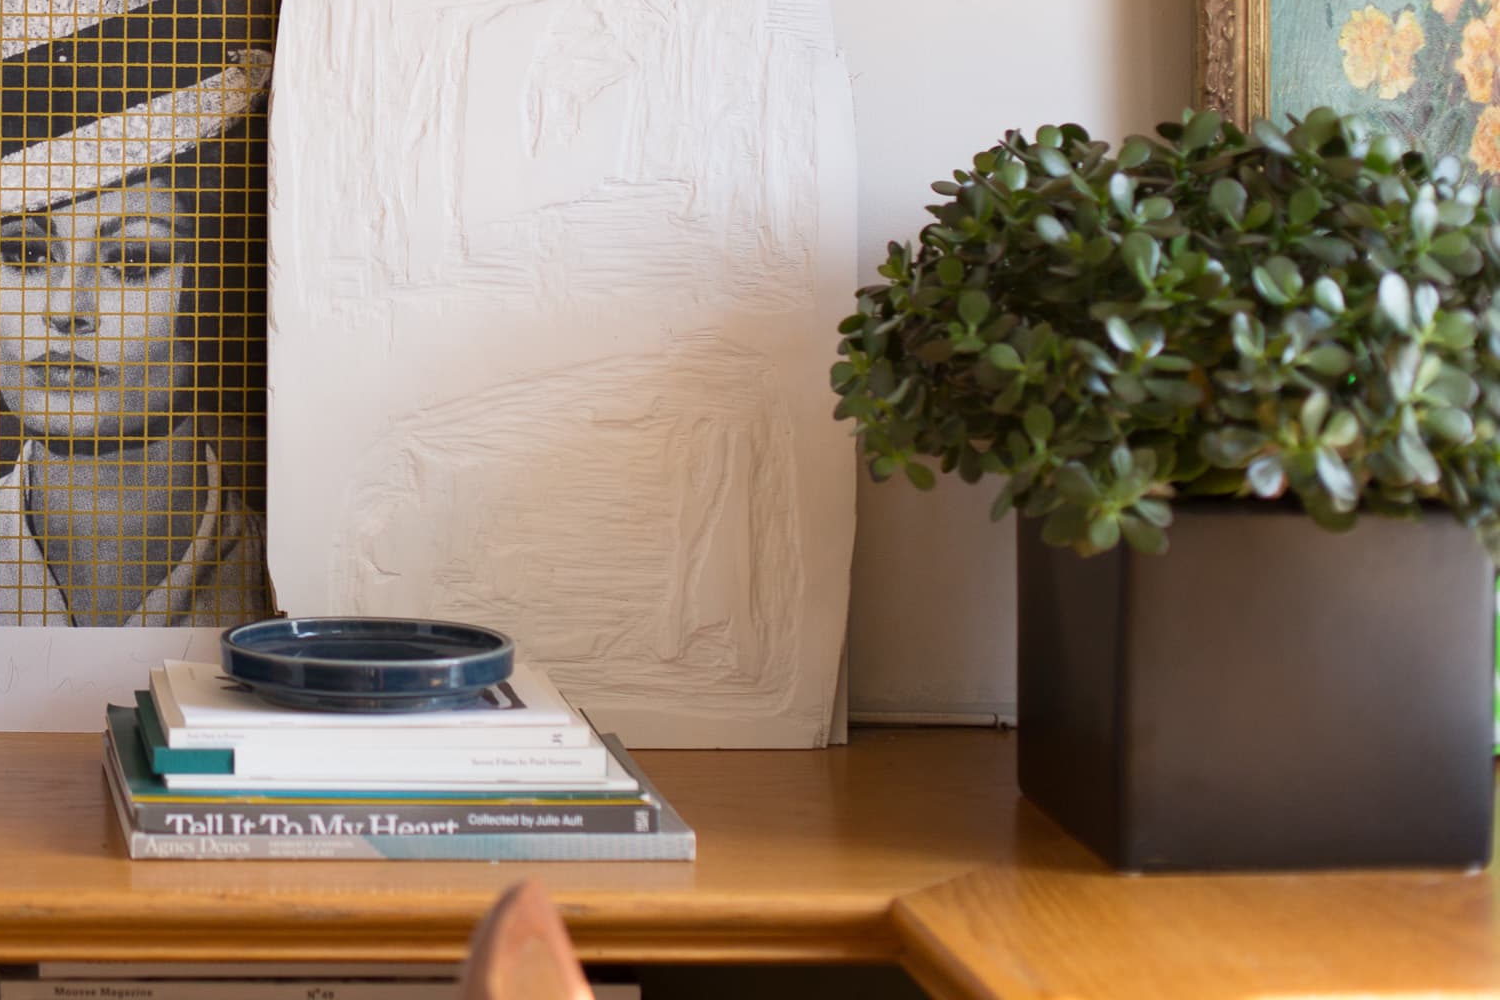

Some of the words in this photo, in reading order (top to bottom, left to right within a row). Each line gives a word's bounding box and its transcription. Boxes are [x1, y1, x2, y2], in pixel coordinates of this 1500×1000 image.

[164, 813, 224, 835] Tell
[229, 813, 257, 835] It
[258, 813, 304, 835] To
[467, 812, 519, 828] Collected
[520, 813, 533, 829] by
[535, 813, 561, 828] Julie
[562, 814, 584, 828] Ault
[144, 836, 196, 857] Agnes
[199, 836, 251, 854] Denes
[54, 986, 98, 998] Mousse
[99, 986, 154, 999] Magazine
